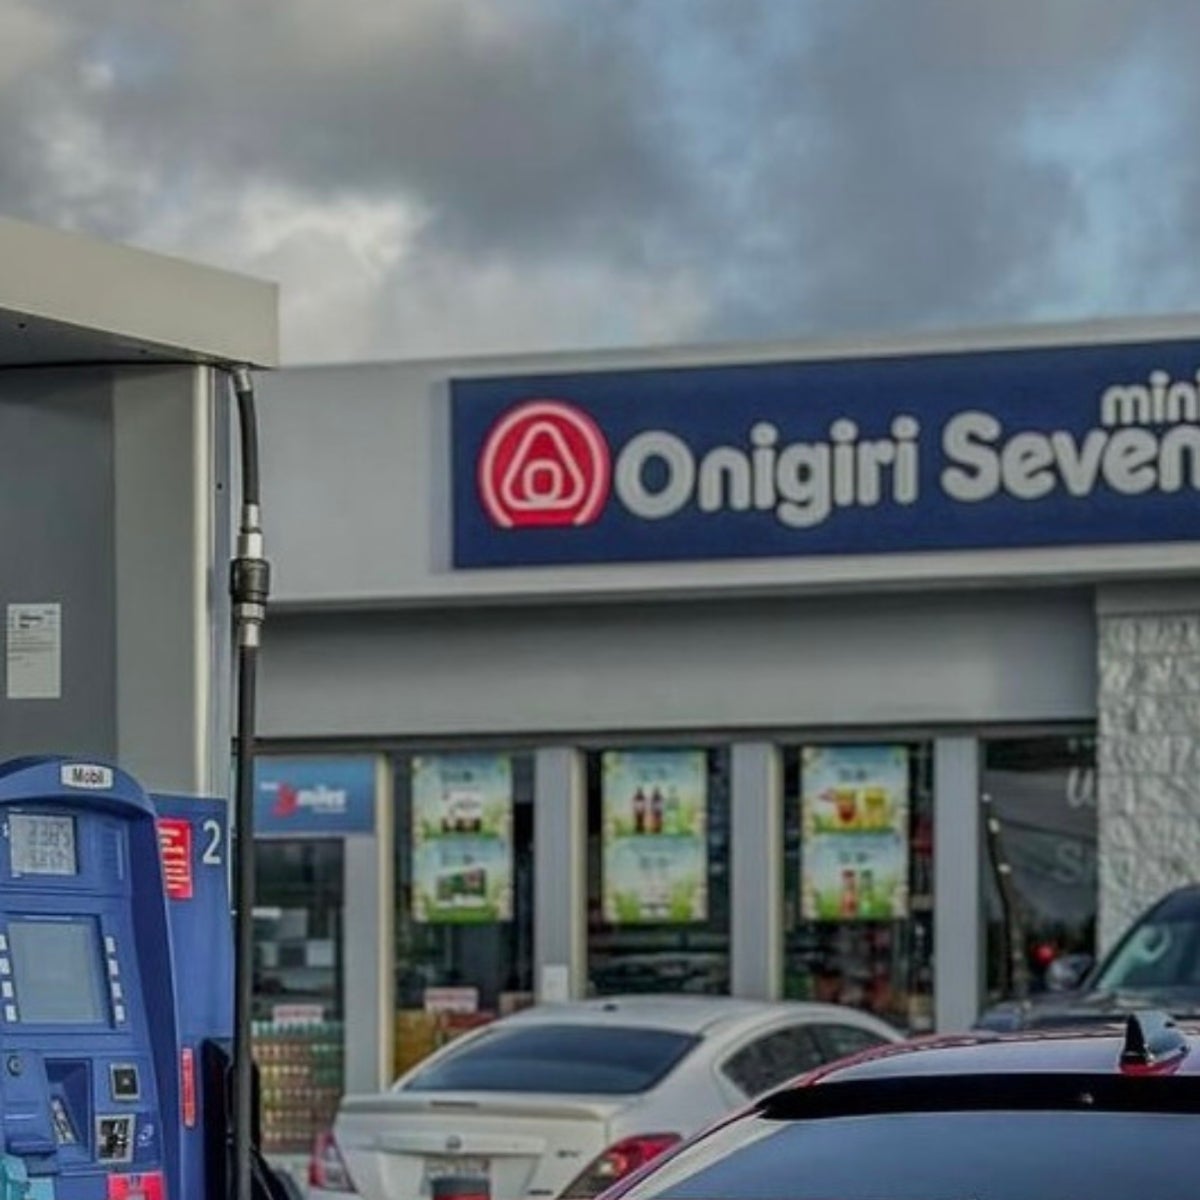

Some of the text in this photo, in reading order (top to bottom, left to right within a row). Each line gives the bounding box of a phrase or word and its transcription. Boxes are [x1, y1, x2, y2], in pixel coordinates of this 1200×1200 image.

[615, 416, 920, 528] Onigiri
[72, 767, 105, 784] Mobil
[203, 819, 222, 865] 2
